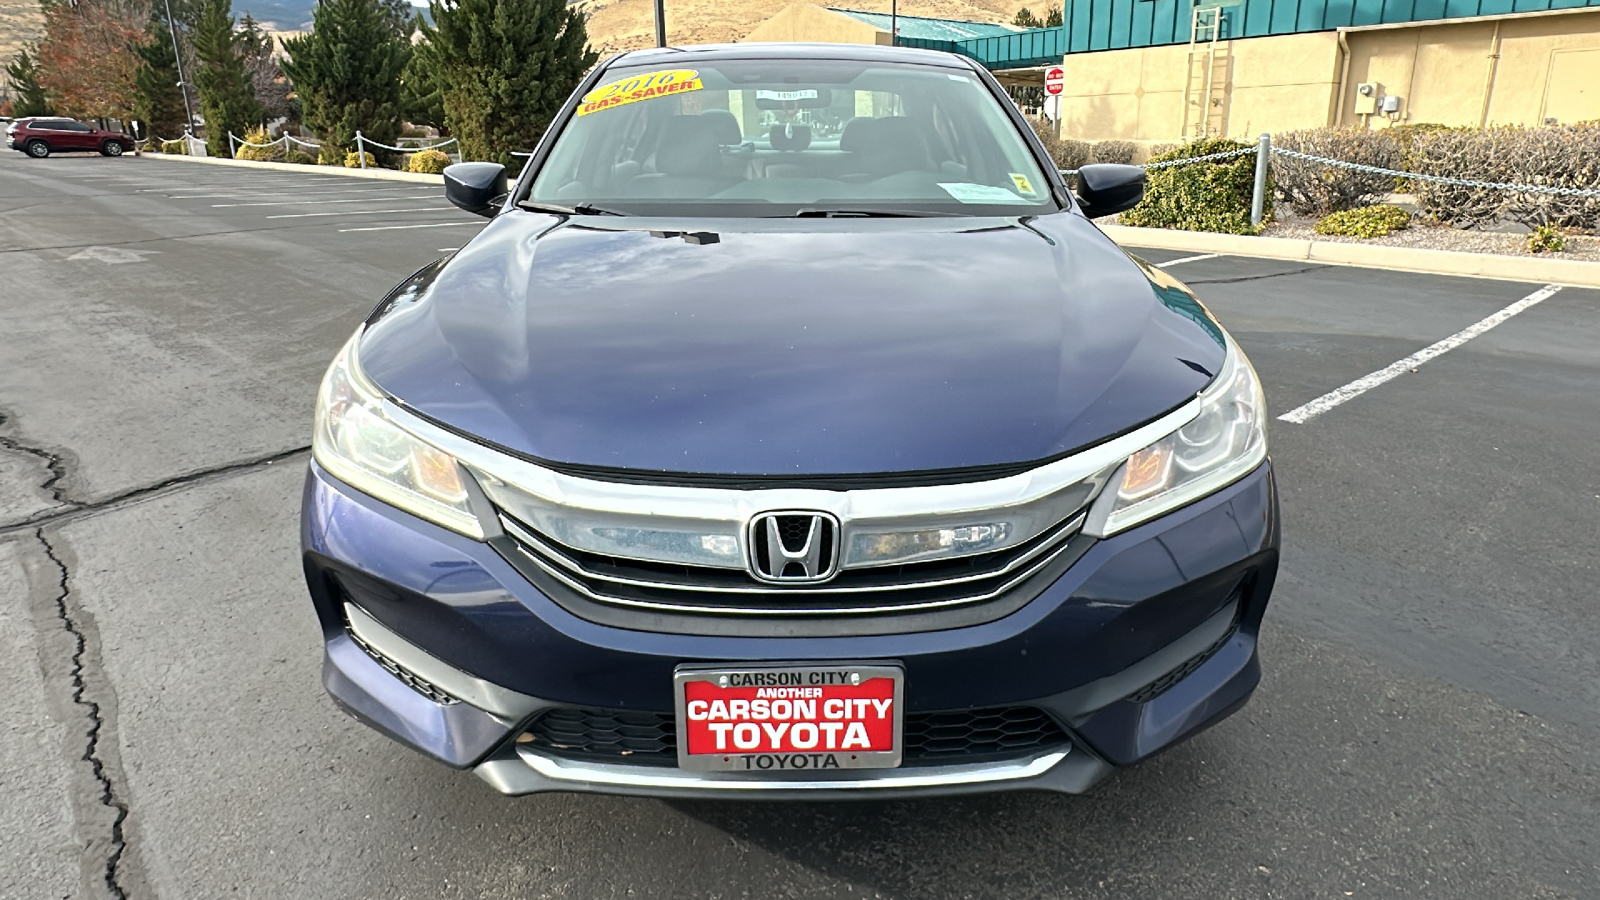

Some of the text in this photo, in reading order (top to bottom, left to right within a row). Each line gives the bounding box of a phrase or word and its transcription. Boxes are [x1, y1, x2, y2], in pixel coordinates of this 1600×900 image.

[603, 72, 677, 98] 2016
[729, 671, 849, 687] CARSON CITY
[756, 687, 823, 699] ANOTHER
[687, 698, 893, 721] CARSON CITY
[708, 722, 872, 750] TOYOTA
[741, 754, 840, 769] TOYOTA
